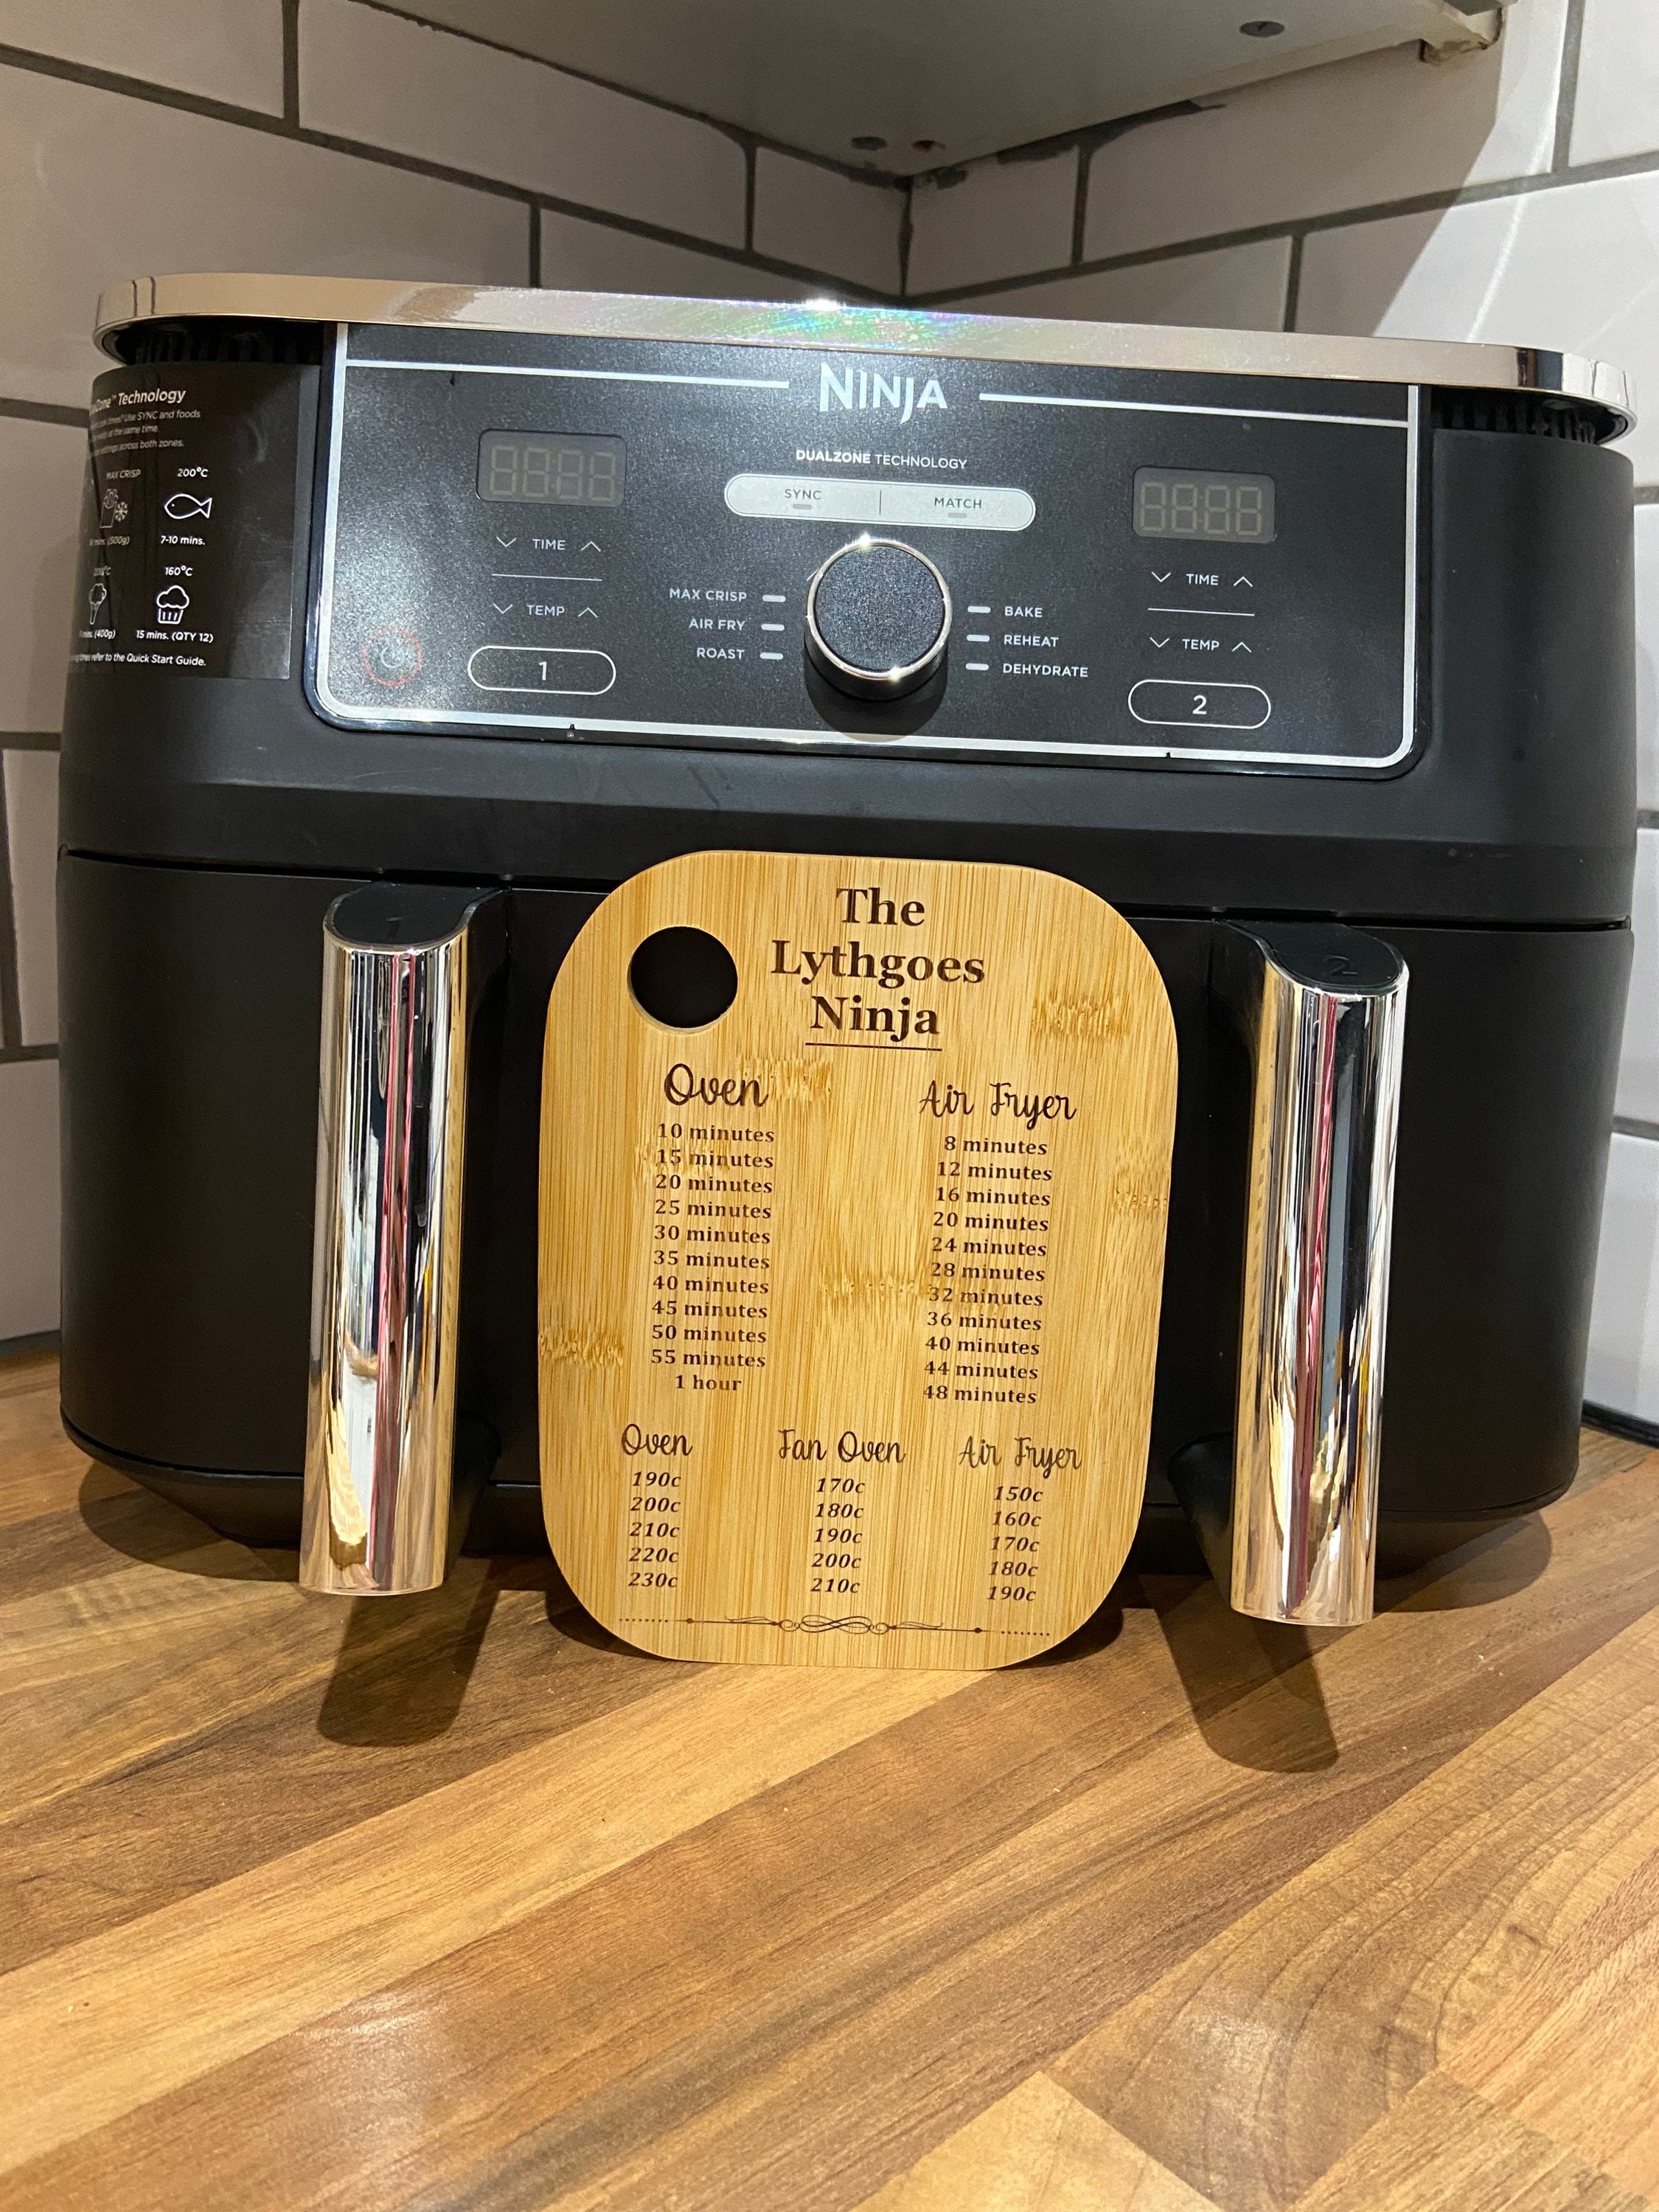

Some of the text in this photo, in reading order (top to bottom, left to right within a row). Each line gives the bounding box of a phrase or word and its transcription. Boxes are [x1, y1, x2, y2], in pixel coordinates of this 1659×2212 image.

[118, 389, 186, 406] Technology
[818, 361, 948, 425] NINJA
[137, 411, 158, 421] SYNC
[159, 410, 174, 419] and
[176, 409, 201, 418] foods
[139, 439, 157, 448] both
[159, 439, 184, 448] zones.
[796, 448, 967, 470] DUALZONE TECHNOLOGY
[119, 469, 141, 479] CRISP
[178, 467, 208, 478] 200°C
[784, 487, 822, 501] SYNC
[933, 496, 982, 510] MATCH
[107, 536, 130, 546] (500g)
[161, 535, 206, 546] 7-10 mins.
[532, 538, 566, 552] TIME
[165, 565, 193, 577] 160°C
[1185, 572, 1219, 586] TIME
[669, 588, 747, 602] MAX CRISP
[526, 604, 565, 618] TEMP
[1004, 605, 1043, 619] BAKE
[689, 618, 745, 630] AIR FRY
[94, 630, 116, 639] (400g)
[136, 630, 214, 644] 15 mins. (QTY 12)
[1003, 633, 1059, 649] REHEAT
[1182, 638, 1220, 652] TEMP
[105, 653, 113, 662] to
[114, 653, 125, 662] the
[127, 653, 150, 664] Quick
[151, 654, 173, 664] Start
[175, 655, 206, 667] Guide.
[697, 647, 745, 660] ROAST
[538, 661, 547, 681] 1
[1002, 663, 1089, 679] DEHYDRATE
[1192, 695, 1207, 716] 2
[836, 886, 925, 927] The
[771, 939, 985, 990] Lythgoes
[810, 994, 940, 1042] Ninja
[664, 1062, 770, 1107] Oven
[919, 1079, 1077, 1131] Air Fryer
[658, 1123, 774, 1143] 10 minutes
[944, 1135, 1048, 1155] 8 minutes
[657, 1149, 773, 1168] 15 minutes
[938, 1161, 1052, 1180] 12 minutes
[655, 1174, 773, 1194] 20 minutes
[936, 1187, 1051, 1206] 16 minutes
[655, 1200, 772, 1219] 25 minutes
[933, 1212, 1048, 1231] 20 minutes
[654, 1225, 771, 1245] 30 minutes
[932, 1237, 1047, 1256] 24 minutes
[653, 1250, 770, 1269] 35 minutes
[931, 1262, 1046, 1281] 28 minutes
[653, 1276, 769, 1294] 40 minutes
[928, 1287, 1043, 1307] 32 minutes
[652, 1301, 768, 1318] 45 minutes
[927, 1312, 1042, 1331] 36 minutes
[652, 1325, 767, 1343] 50 minutes
[925, 1336, 1040, 1355] 40 minutes
[651, 1349, 766, 1368] 55 minutes
[925, 1361, 1039, 1380] 44 minutes
[675, 1375, 742, 1391] 1 hour
[923, 1385, 1037, 1404] 48 minutes
[621, 1423, 693, 1456] Oven
[778, 1429, 905, 1464] Fan Oven
[959, 1436, 1082, 1479] Air Fryer
[632, 1471, 681, 1487] 190c
[816, 1478, 866, 1494] 170c
[994, 1486, 1043, 1502] 150c
[630, 1497, 681, 1512] 200c
[815, 1503, 864, 1519] 180c
[992, 1511, 1042, 1527] 160c
[629, 1522, 680, 1538] 210c
[814, 1528, 863, 1544] 190c
[991, 1536, 1040, 1552] 170c
[629, 1548, 679, 1563] 220c
[811, 1554, 861, 1569] 200c
[989, 1561, 1038, 1577] 180c
[628, 1573, 678, 1588] 230c
[810, 1579, 860, 1594] 210c
[987, 1585, 1036, 1601] 190c
